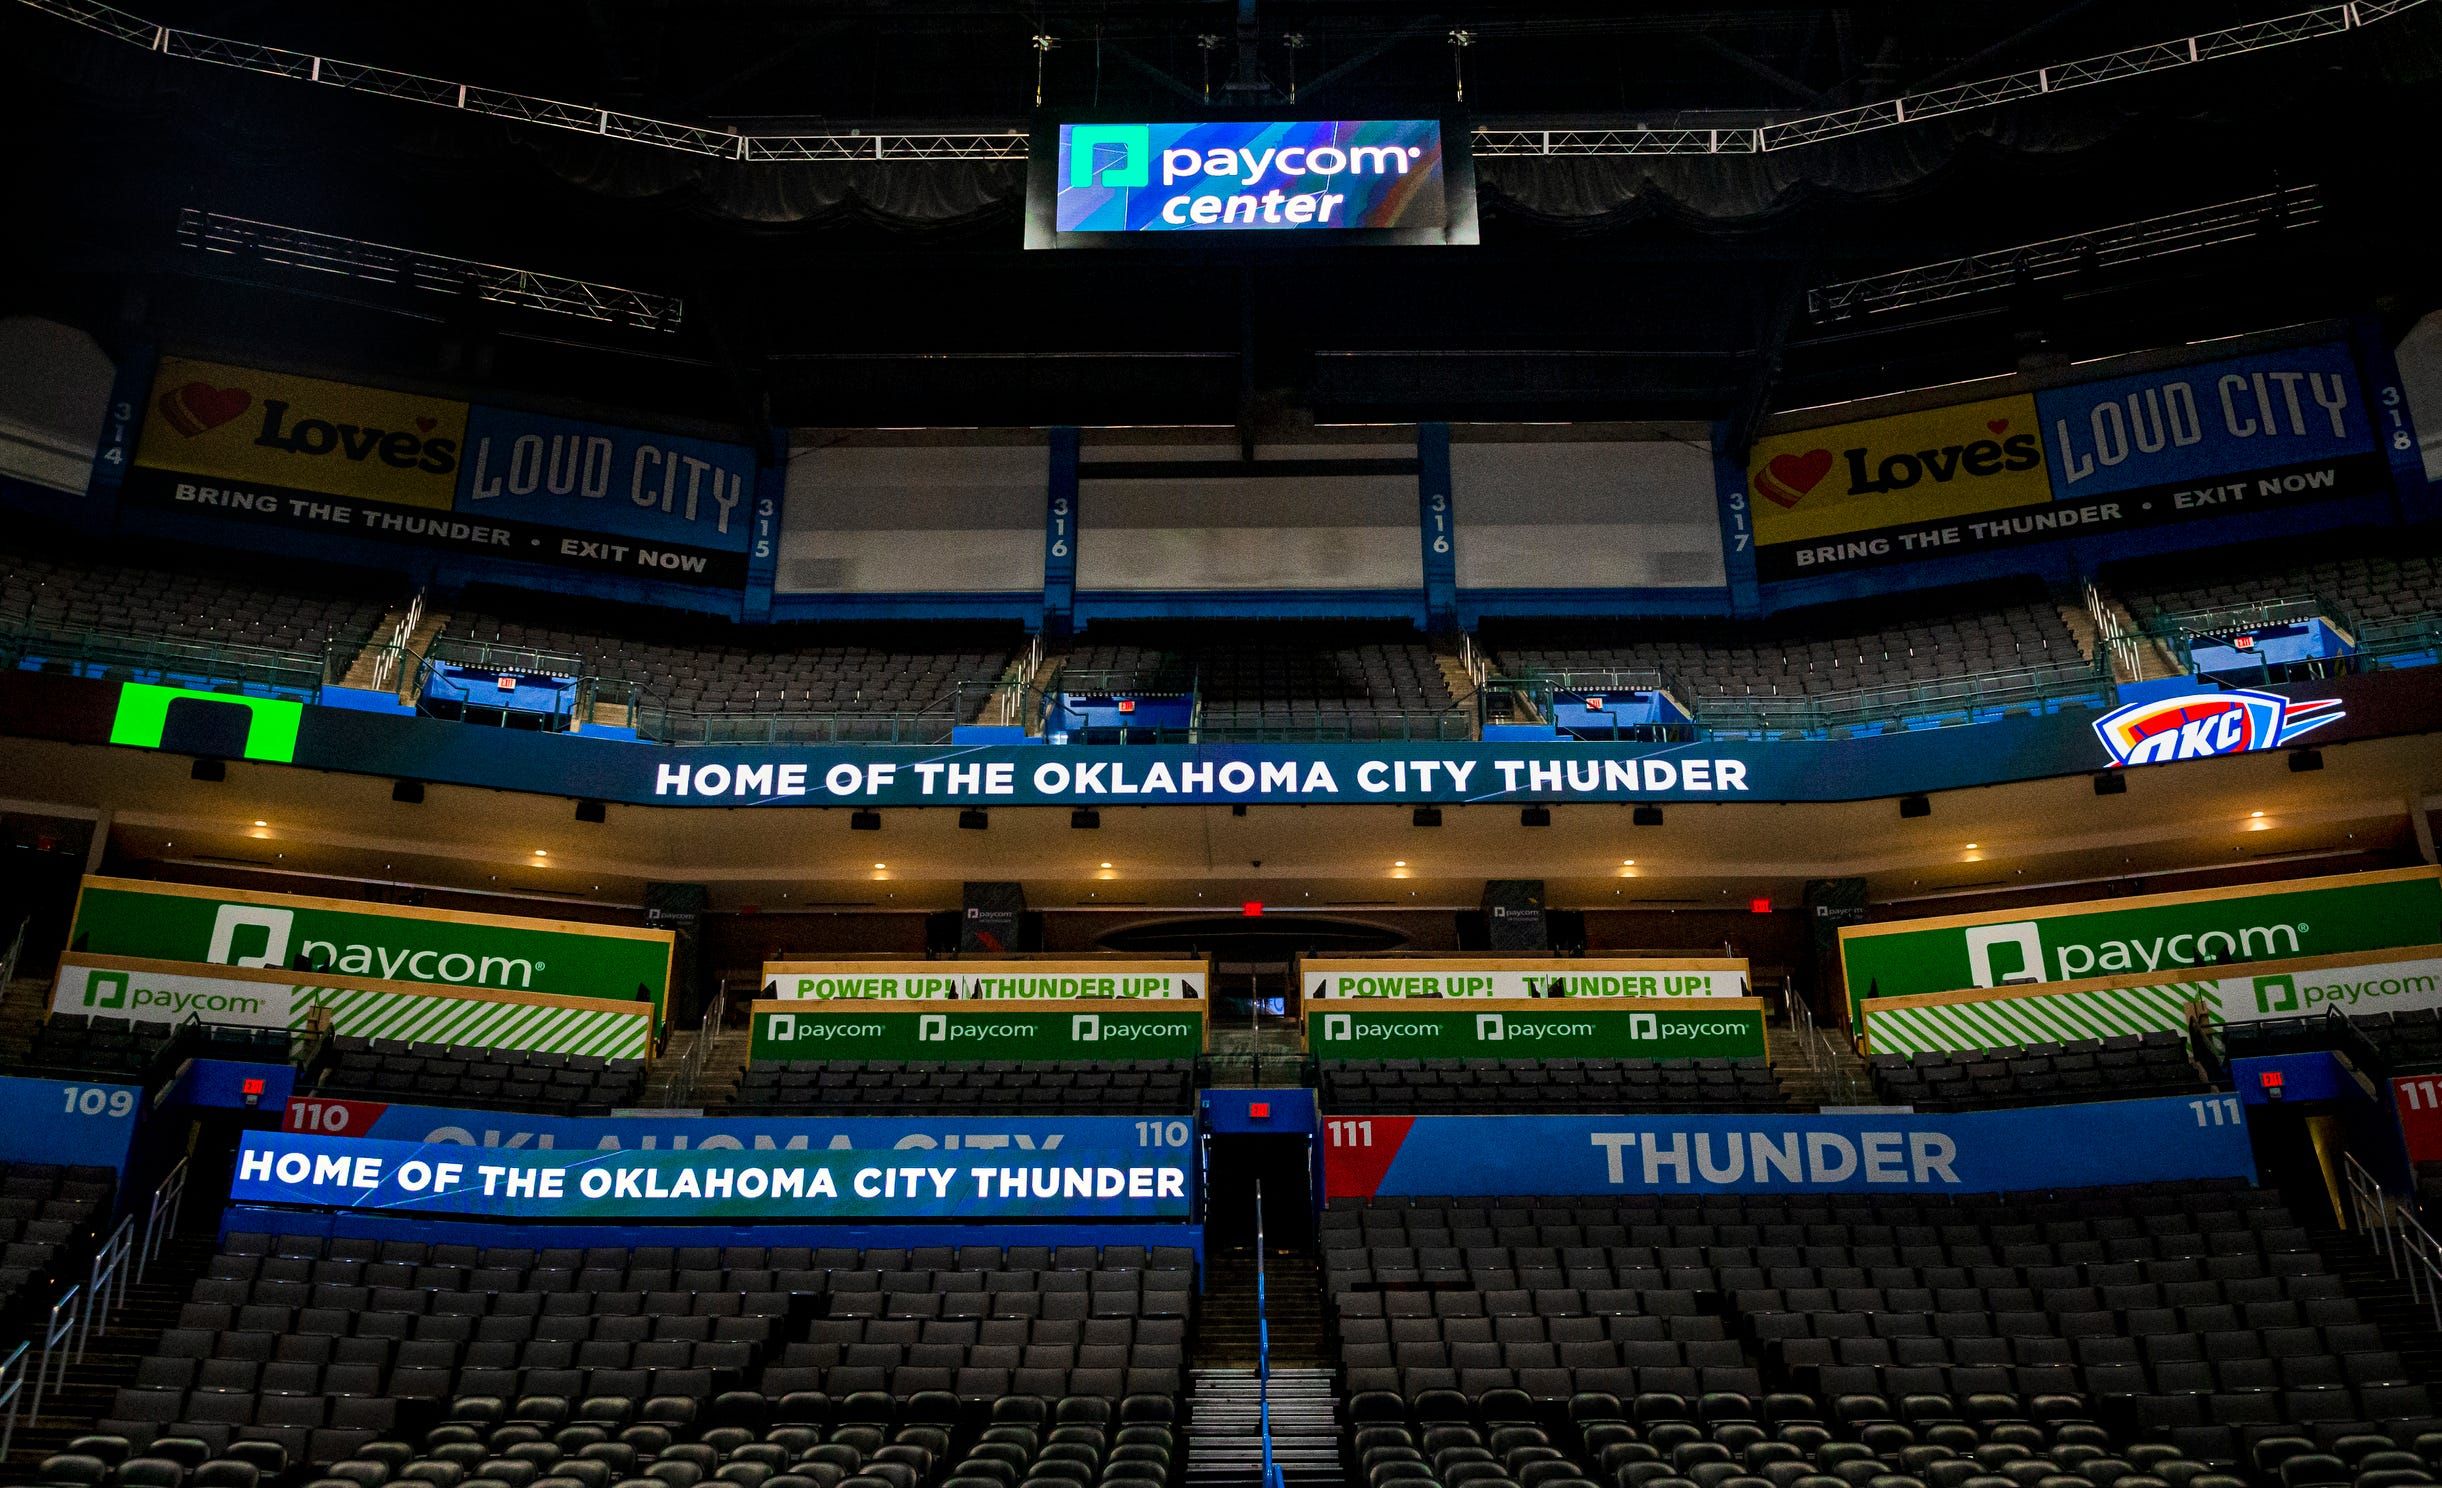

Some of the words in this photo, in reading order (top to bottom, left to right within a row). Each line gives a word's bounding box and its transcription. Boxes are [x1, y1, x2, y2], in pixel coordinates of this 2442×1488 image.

[1161, 189, 1343, 225] center
[2056, 381, 2202, 486] LOUD
[2217, 372, 2349, 439] CITY
[471, 434, 614, 500] LOUD
[631, 443, 742, 535] CITY
[175, 483, 278, 513] BRING
[288, 498, 351, 525] THE
[361, 510, 512, 546] THUNDER
[561, 538, 633, 563] EXIT
[637, 549, 709, 574] NOW
[1795, 537, 1890, 567] BRING
[1898, 527, 1961, 551] THE
[1968, 504, 2124, 539] THUNDER
[2173, 482, 2248, 510] EXIT
[2256, 469, 2335, 497] NOW
[655, 763, 808, 796] HOME
[825, 763, 897, 796] OF
[914, 762, 1014, 795] THE
[1033, 761, 1339, 795] OKLAHOMA
[1356, 760, 1478, 793] CITY
[1494, 759, 1750, 792] THUNDER
[797, 978, 898, 999] POWER
[981, 978, 1116, 998] THUNDER
[1123, 977, 1170, 998] UP!
[1338, 977, 1440, 997] POWER
[1446, 977, 1494, 997] UP!
[1664, 976, 1712, 997] UP!
[2303, 975, 2436, 1009] paycom
[131, 988, 260, 1014] paycom
[799, 1024, 882, 1041] paycom
[950, 1024, 1034, 1041] paycom
[1103, 1023, 1187, 1040] paycom
[1356, 1023, 1439, 1040] paycom
[1508, 1023, 1592, 1040] paycom
[1662, 1022, 1746, 1039] paycom
[63, 1087, 134, 1118] 109
[2400, 1080, 2442, 1110] 11
[291, 1103, 350, 1132] 110
[2189, 1098, 2241, 1127] 111
[1135, 1121, 1189, 1147] 110
[1327, 1120, 1373, 1147] 111
[1590, 1132, 1962, 1184] THUNDER
[239, 1150, 383, 1189] HOME
[397, 1160, 463, 1193] OF
[478, 1165, 566, 1198] THE
[580, 1168, 838, 1199] OKLAHOMA
[854, 1167, 957, 1198] CITY
[971, 1167, 1185, 1198] THUNDER
